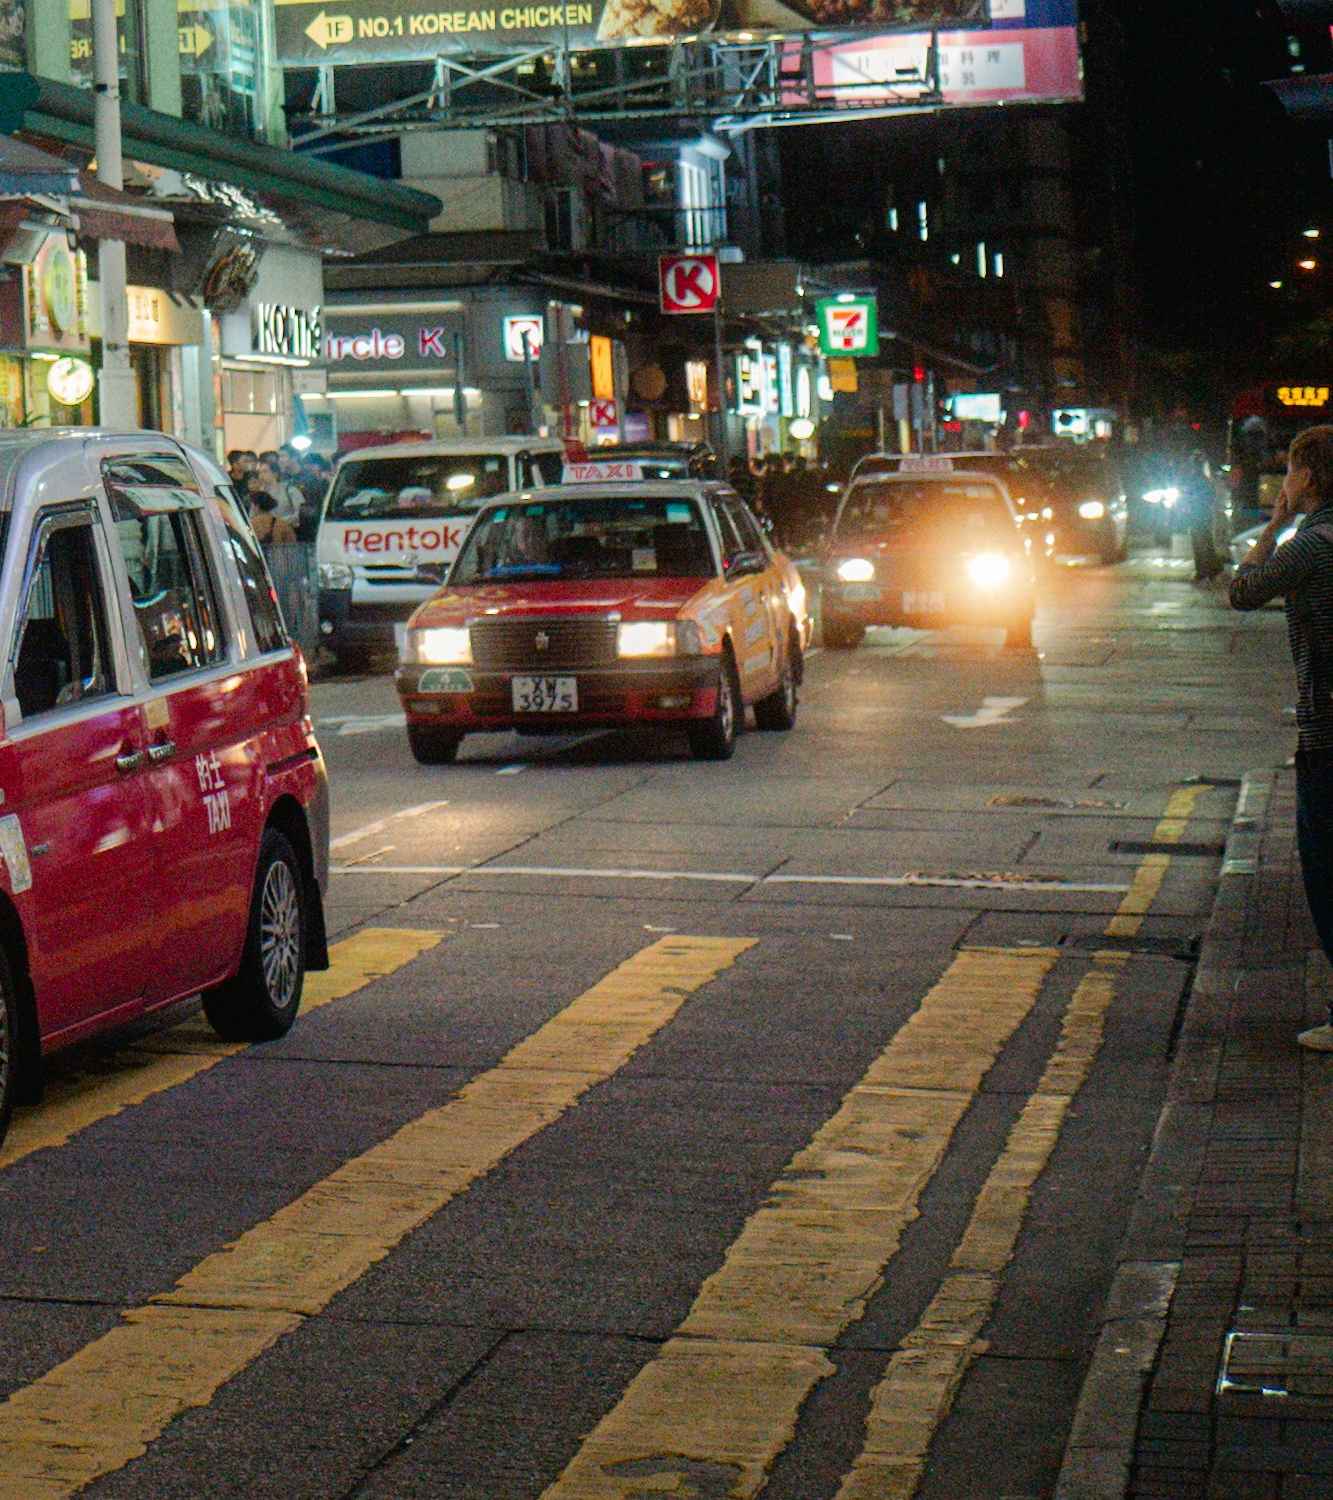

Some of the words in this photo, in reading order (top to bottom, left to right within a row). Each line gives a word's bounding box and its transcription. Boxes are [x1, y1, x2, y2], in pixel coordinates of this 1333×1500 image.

[326, 21, 346, 38] 1F
[359, 14, 404, 39] NO.1
[410, 9, 496, 36] KOREAN
[501, 3, 593, 30] CHICKEN
[674, 264, 714, 301] K
[326, 327, 405, 360] ircle
[418, 326, 447, 358] K
[569, 463, 634, 481] TAXI
[344, 523, 470, 554] Rentok
[196, 751, 225, 793] 的士
[203, 790, 231, 834] TAXI
